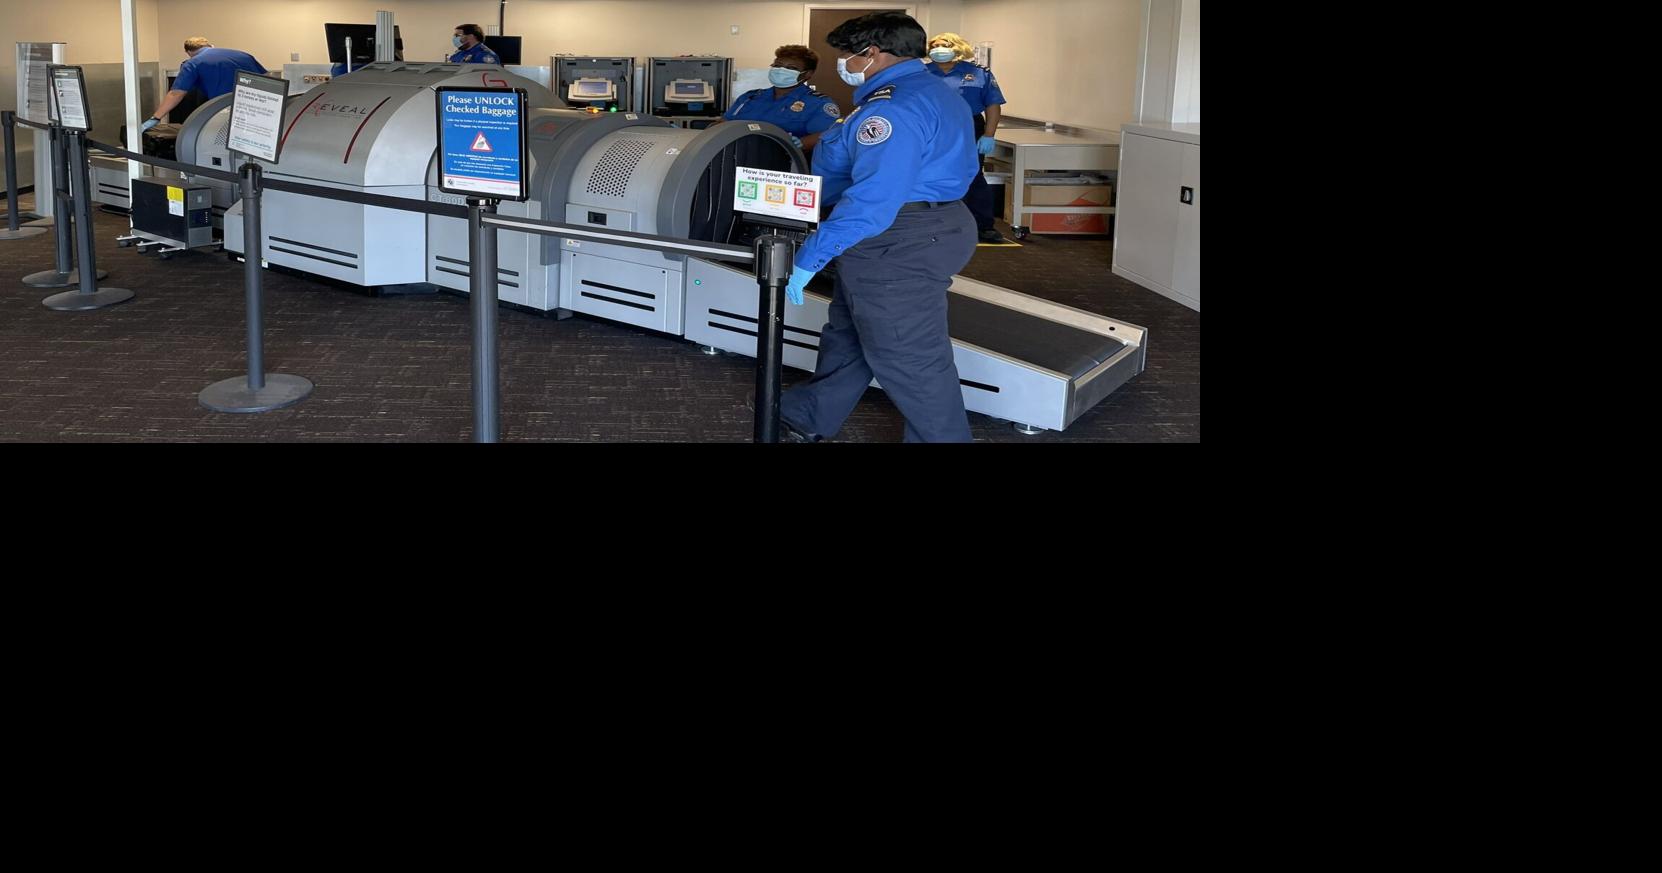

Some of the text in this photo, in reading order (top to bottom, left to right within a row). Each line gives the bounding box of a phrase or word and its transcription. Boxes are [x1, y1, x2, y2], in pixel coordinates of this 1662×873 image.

[447, 95, 514, 106] Please UNLOCK
[446, 105, 516, 117] Checked Baggage
[747, 175, 783, 184] experience
[783, 173, 814, 182] traveling
